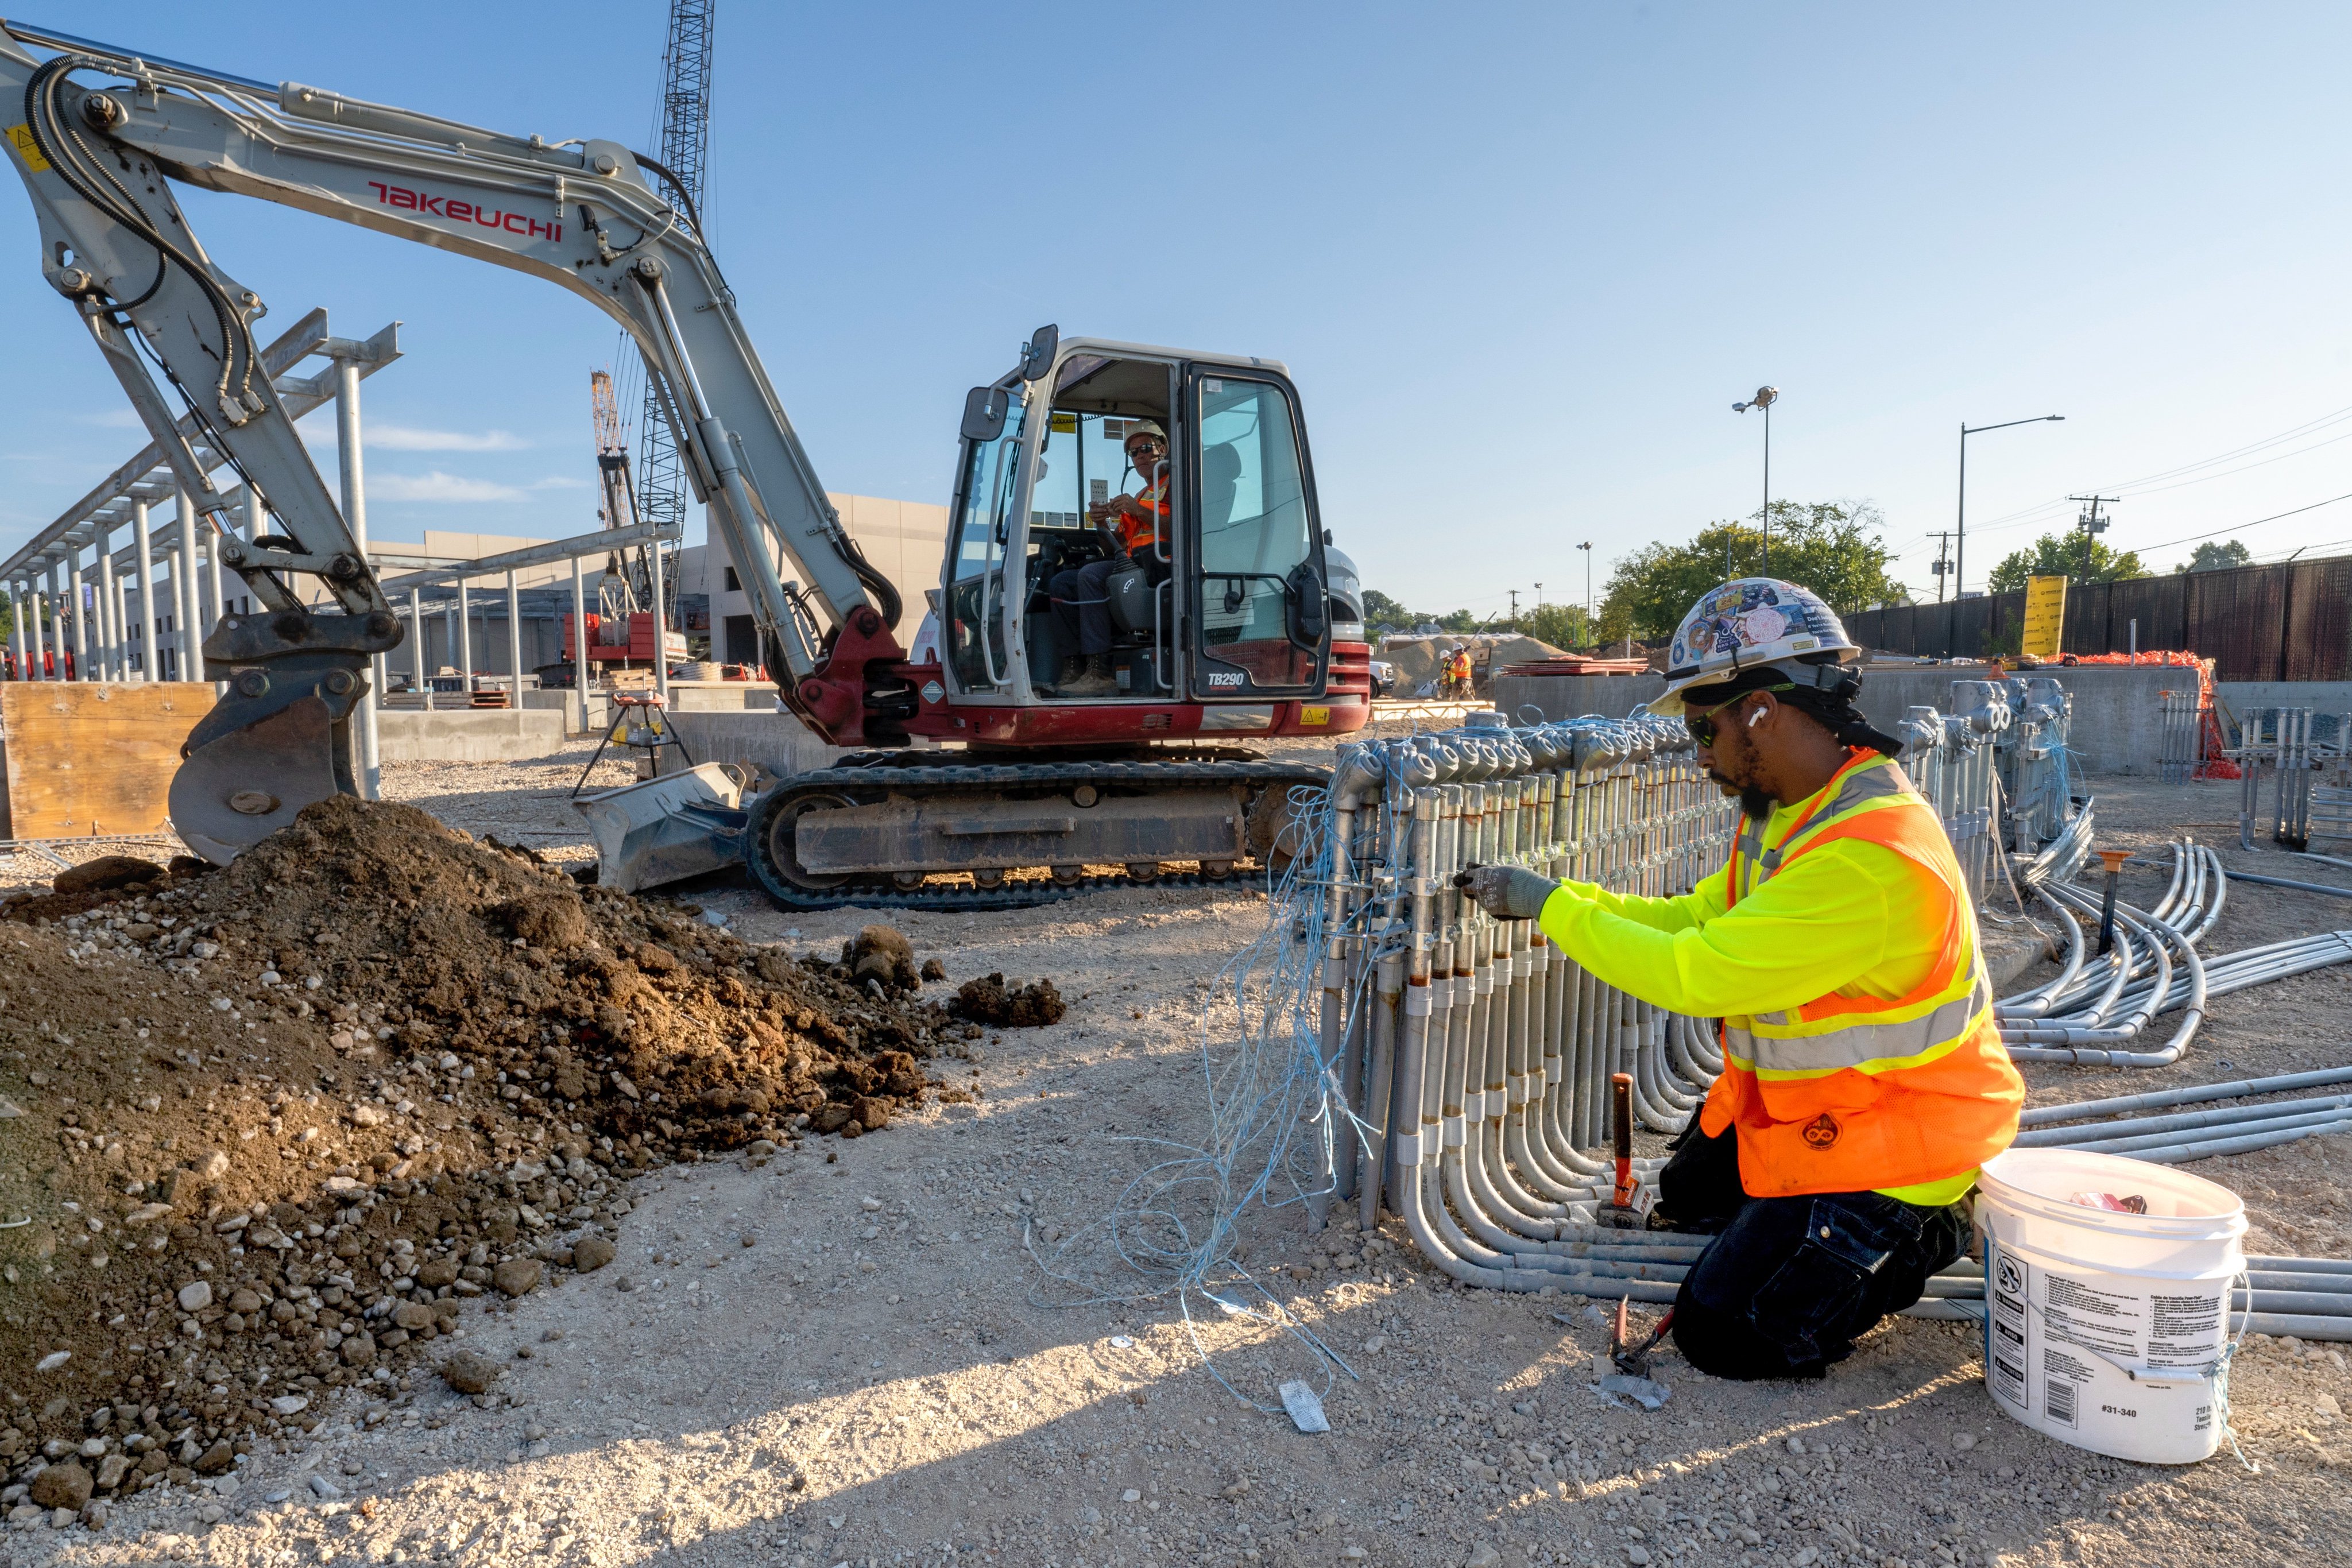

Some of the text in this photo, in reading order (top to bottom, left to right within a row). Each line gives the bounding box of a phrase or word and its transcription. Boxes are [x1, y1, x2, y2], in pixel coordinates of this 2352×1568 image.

[368, 181, 562, 243] TAKEUCHI
[1209, 673, 1244, 686] TB290
[2005, 1328, 2018, 1340] AVISO
[2102, 1405, 2137, 1417] #31-340
[2196, 1407, 2206, 1415] 210
[2196, 1414, 2211, 1422] Tensile
